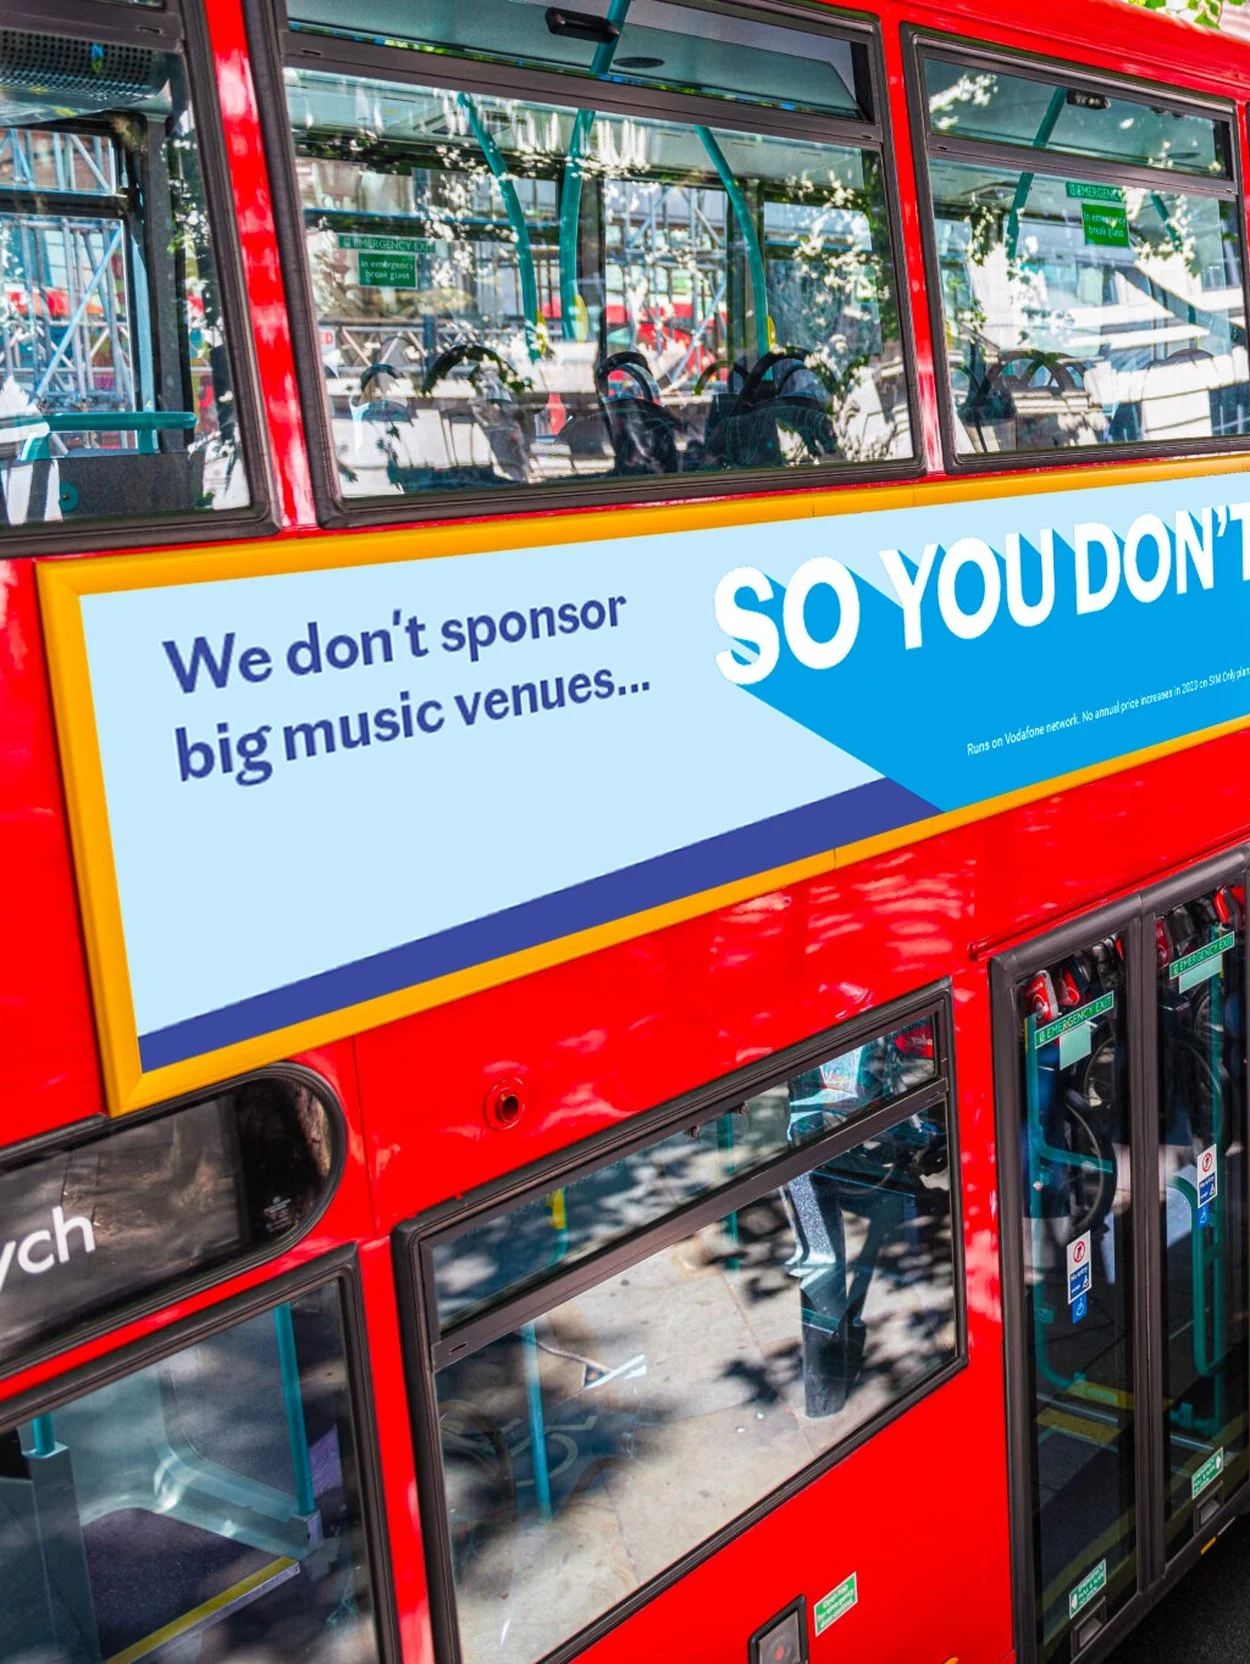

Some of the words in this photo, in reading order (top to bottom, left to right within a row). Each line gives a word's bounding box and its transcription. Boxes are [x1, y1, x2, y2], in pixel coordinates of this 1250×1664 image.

[1077, 185, 1122, 200] EMERGENC
[353, 239, 411, 251] EMERGENCY
[371, 261, 413, 271] emergency
[715, 555, 860, 686] SO
[879, 527, 1055, 650] YOU
[163, 633, 272, 694] We
[286, 609, 428, 677] don't
[440, 596, 626, 662] sponsor
[175, 722, 273, 786] big
[283, 691, 445, 761] music
[453, 668, 650, 726] venues...
[967, 740, 990, 756] Runs
[992, 736, 1003, 750] on
[1005, 724, 1044, 745] Vodafone
[1046, 712, 1081, 734] network.
[1082, 710, 1093, 723] No
[1095, 701, 1120, 719] annual
[1121, 697, 1139, 714] price
[1141, 689, 1172, 706] increases
[1182, 680, 1199, 694] 2023
[1178, 944, 1219, 974] EMERGENCY
[1219, 936, 1234, 953] EXIT
[1046, 1008, 1094, 1043] EMERGENCY
[1095, 995, 1113, 1017] EXIT
